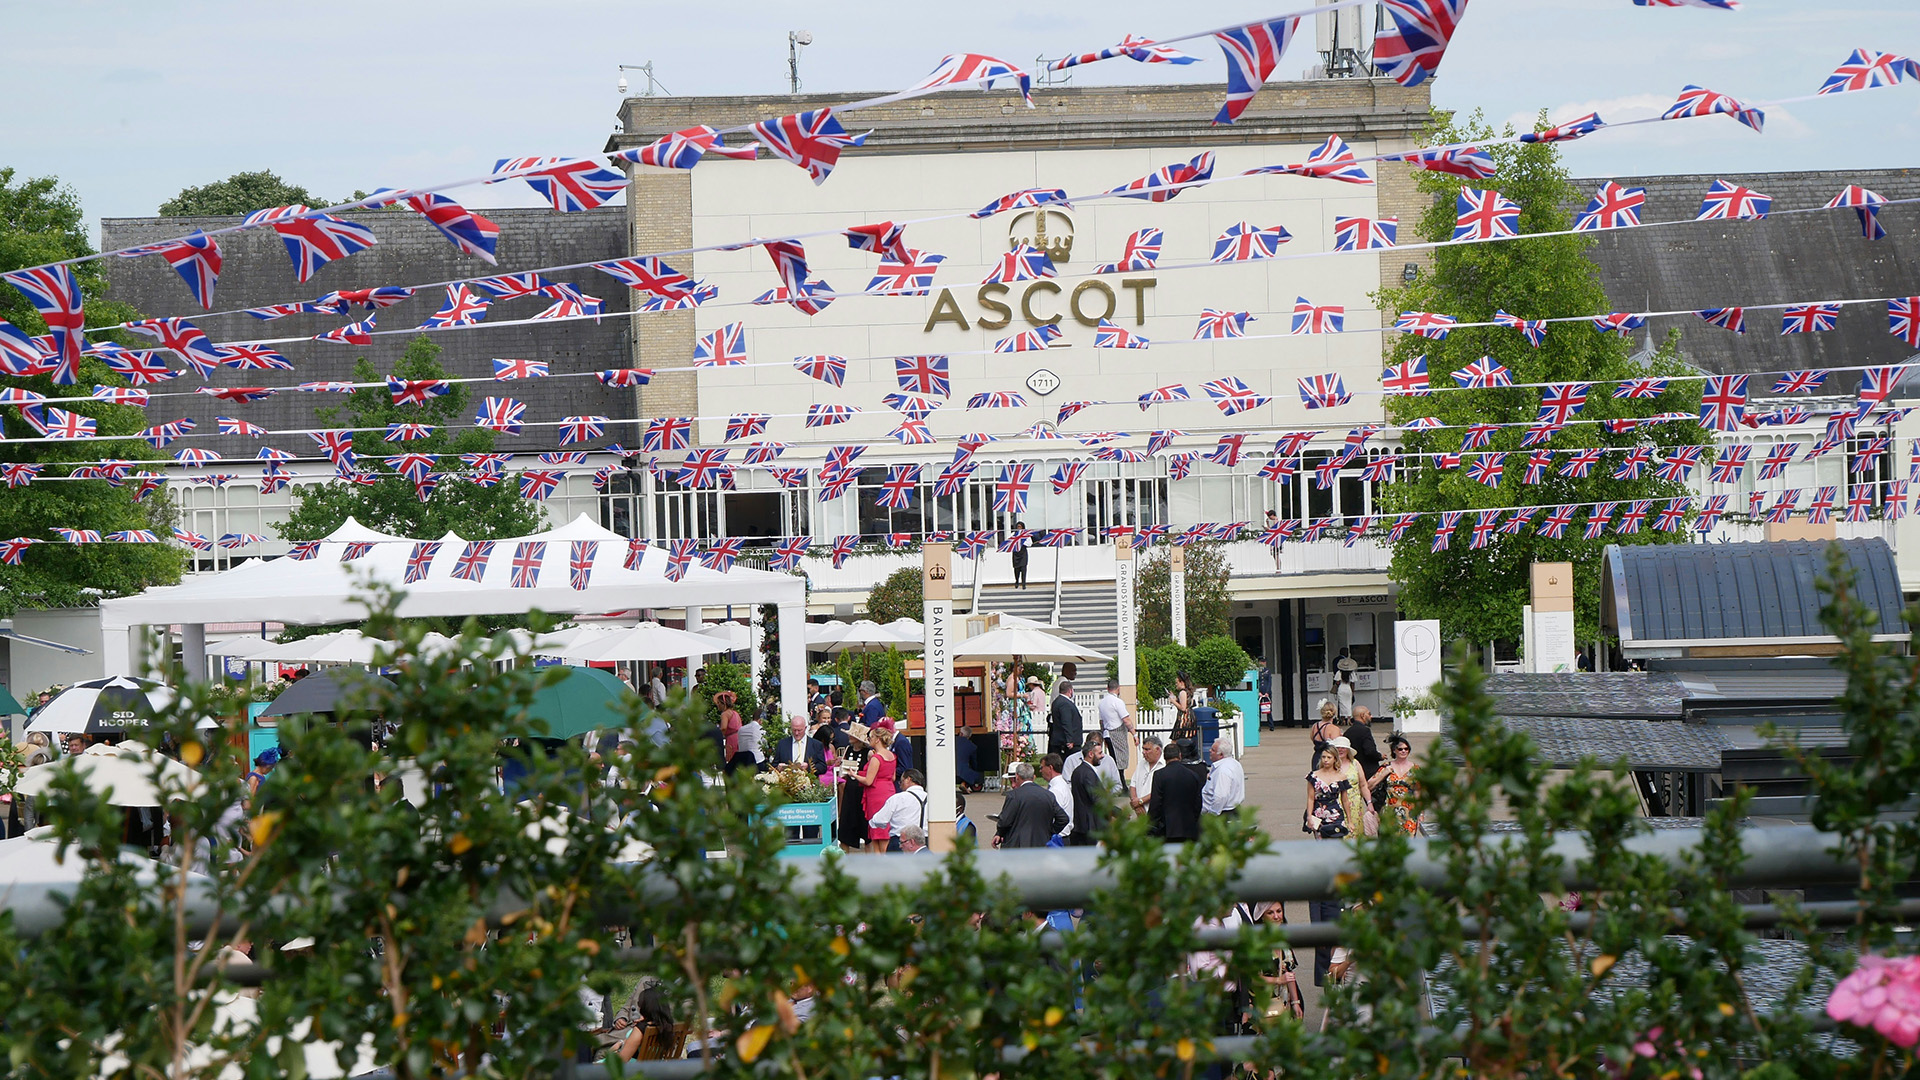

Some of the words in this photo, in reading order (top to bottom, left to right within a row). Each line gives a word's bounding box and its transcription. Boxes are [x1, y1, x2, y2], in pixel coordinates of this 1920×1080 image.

[924, 278, 1158, 332] ASCOT
[1033, 379, 1053, 387] 1711
[1120, 563, 1128, 623] GRANDSTAND
[1359, 595, 1388, 603] ASCOT
[1121, 625, 1129, 651] LAWN
[932, 606, 945, 698] BANDSTAND
[98, 719, 149, 727] HOOPER
[112, 711, 135, 719] SID
[934, 705, 946, 747] LAWN
